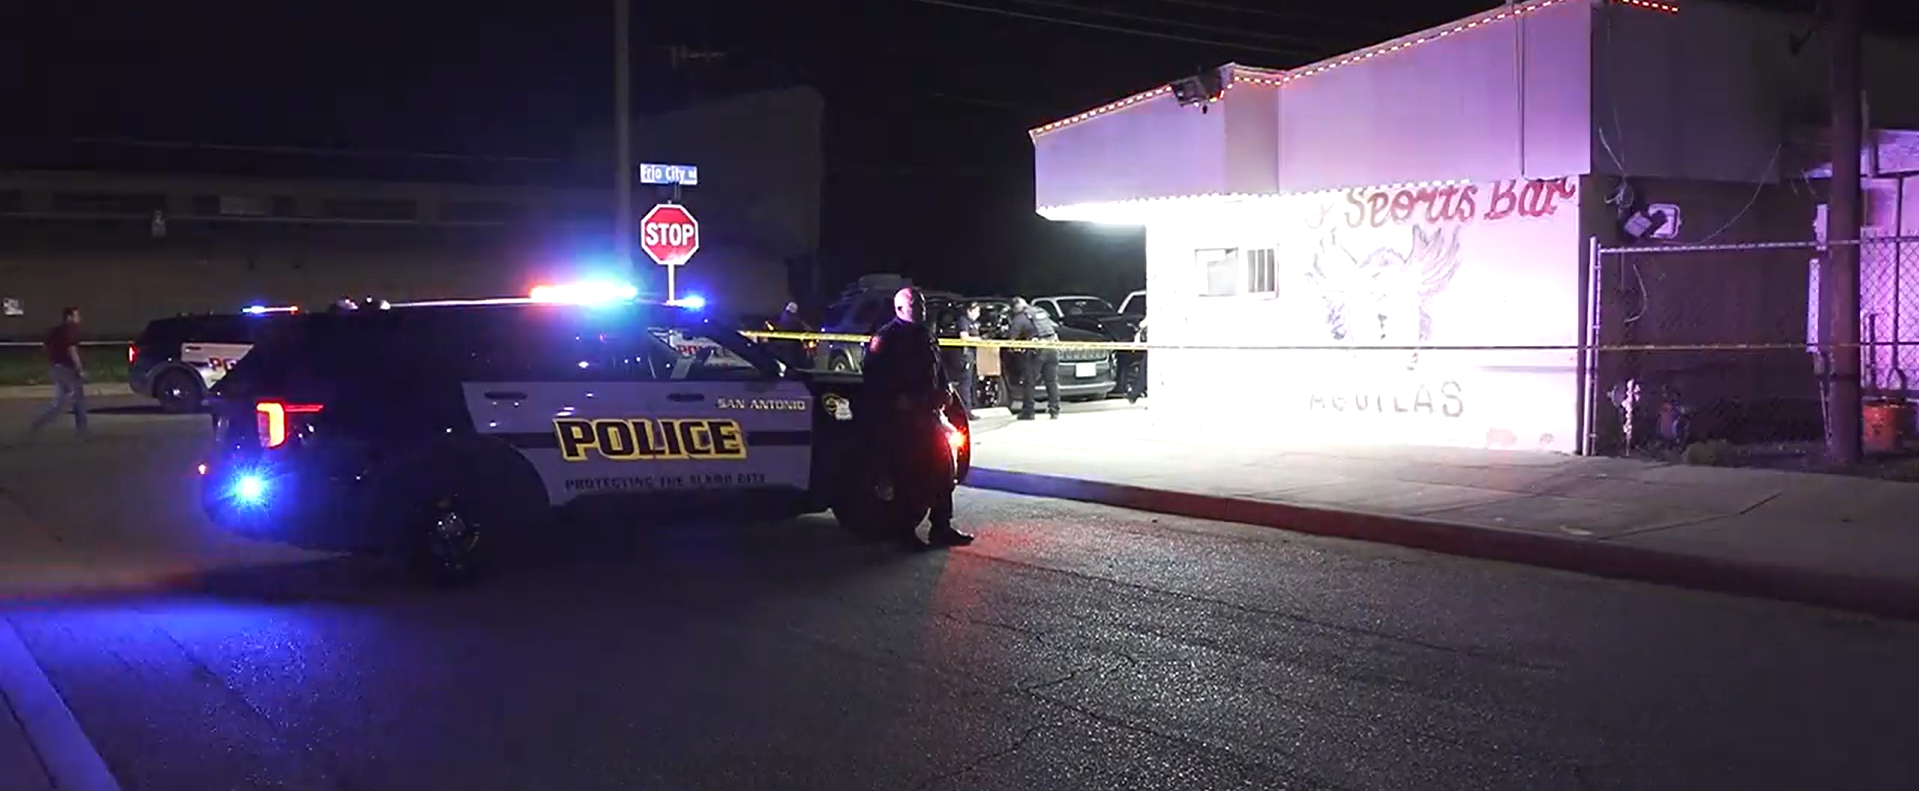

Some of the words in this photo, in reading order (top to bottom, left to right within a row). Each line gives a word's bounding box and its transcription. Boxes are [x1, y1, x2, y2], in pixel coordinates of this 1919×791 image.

[665, 166, 684, 181] City
[646, 223, 694, 246] STOP
[717, 398, 745, 410] SAN
[750, 398, 806, 411] ANTONIO
[553, 418, 748, 461] POLICE
[565, 477, 653, 491] PROTECTING
[660, 475, 684, 487] THE
